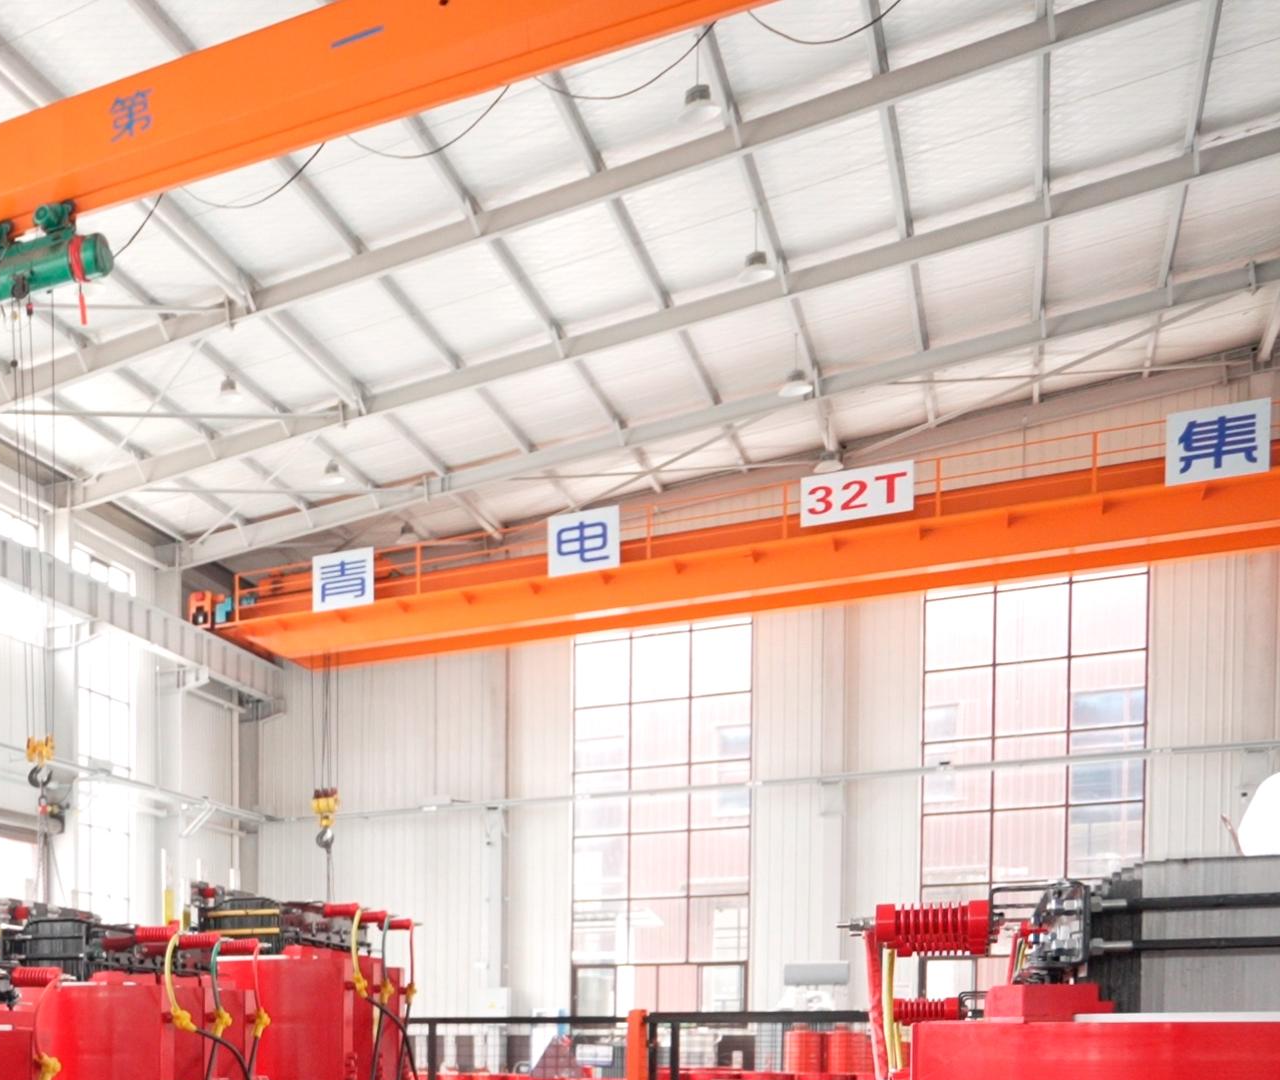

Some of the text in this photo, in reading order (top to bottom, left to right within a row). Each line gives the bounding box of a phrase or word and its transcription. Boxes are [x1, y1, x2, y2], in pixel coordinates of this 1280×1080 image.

[110, 87, 153, 143] 第
[1178, 413, 1258, 474] 集
[807, 471, 908, 516] 32T
[556, 521, 610, 563] 电
[320, 559, 366, 602] 青
